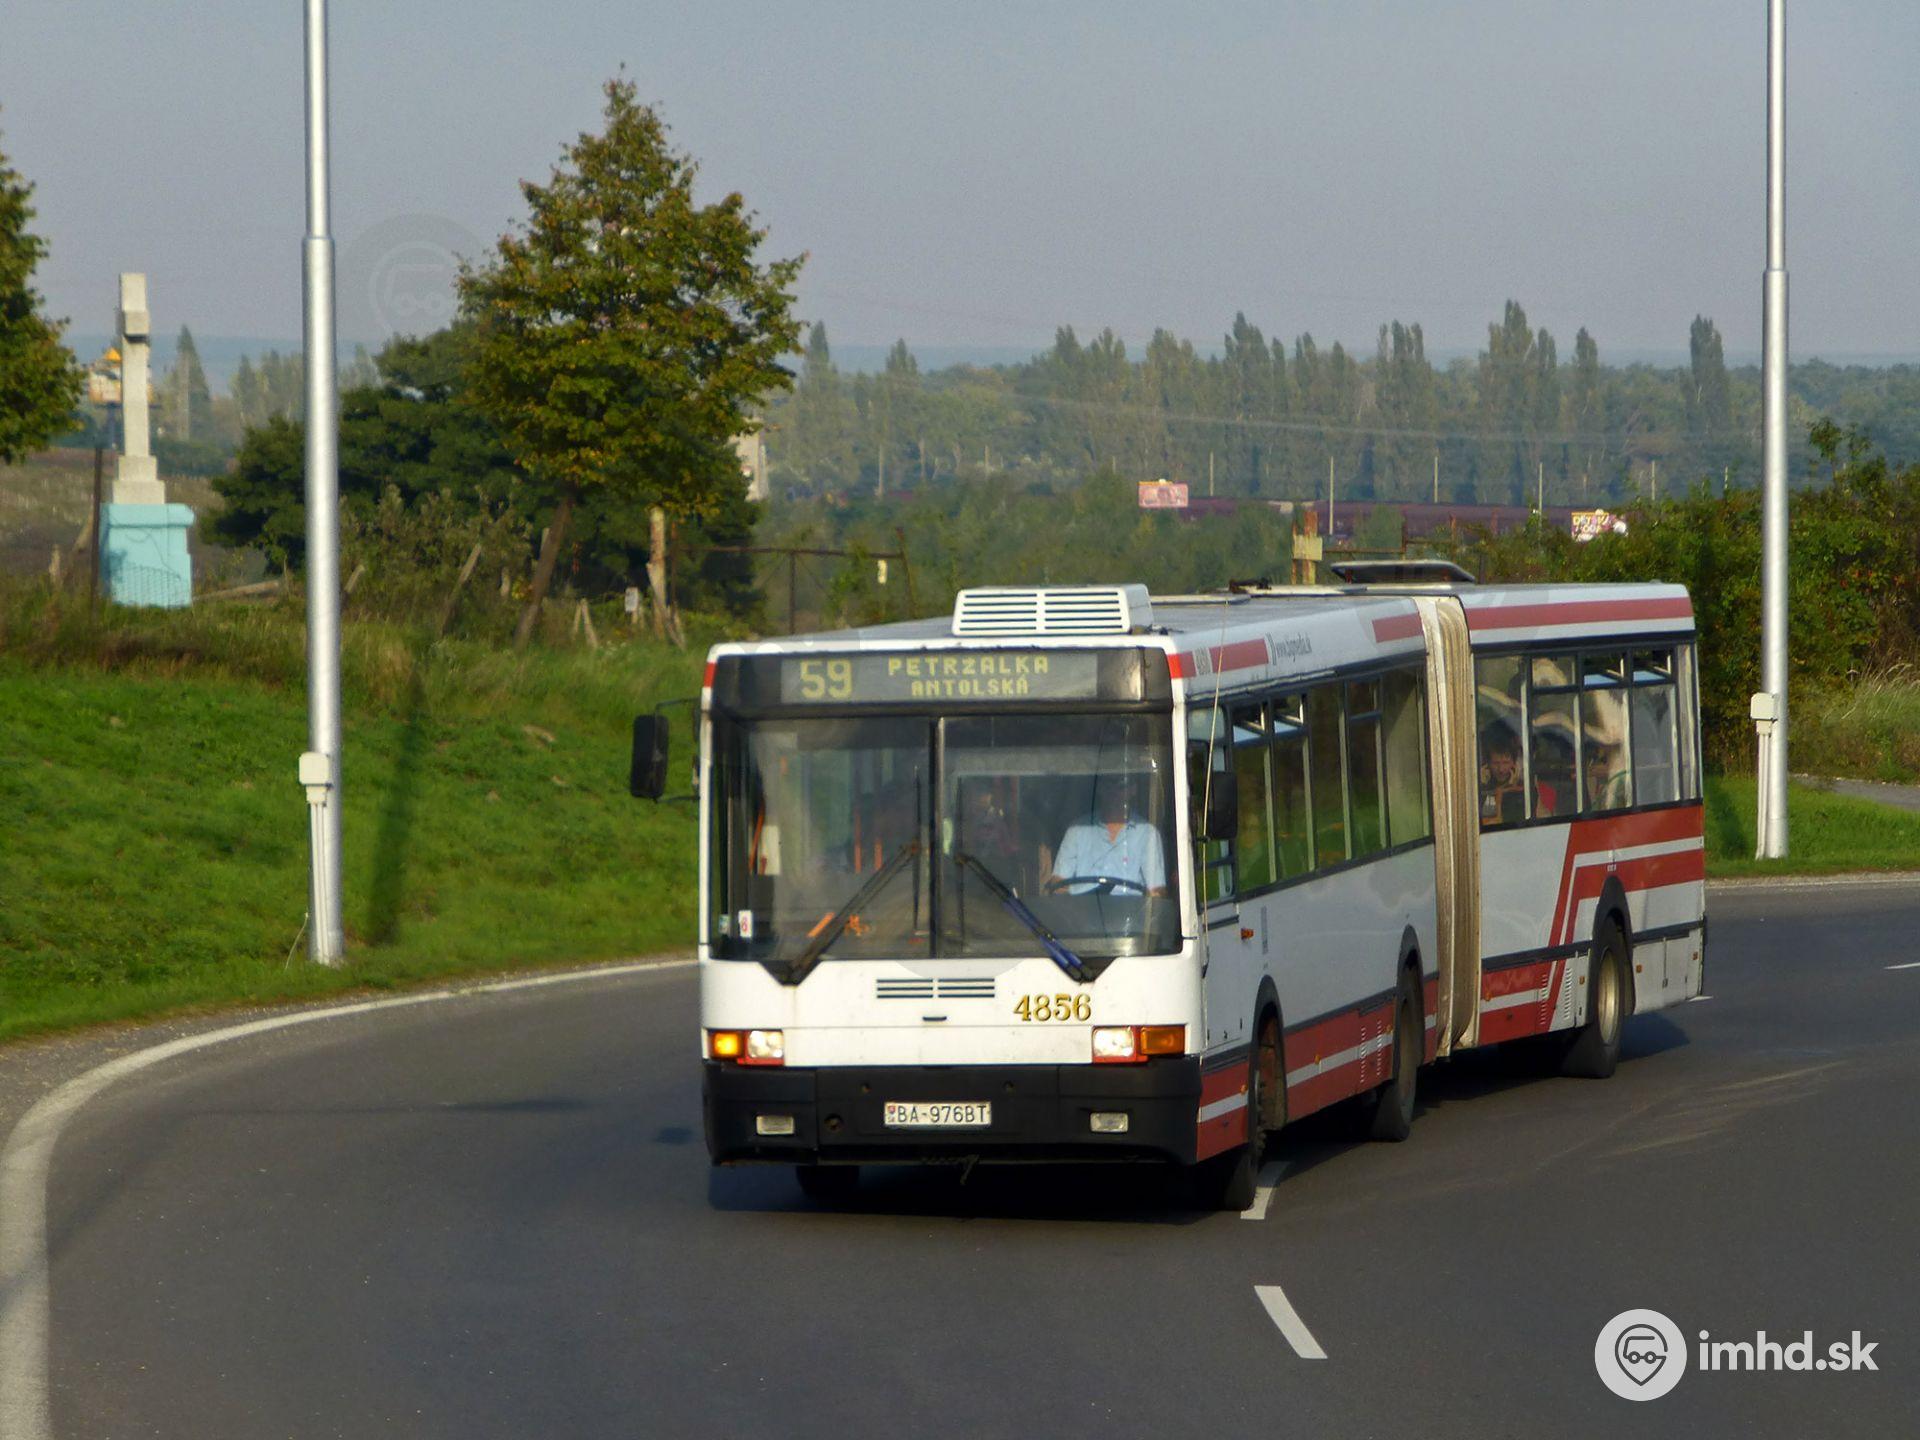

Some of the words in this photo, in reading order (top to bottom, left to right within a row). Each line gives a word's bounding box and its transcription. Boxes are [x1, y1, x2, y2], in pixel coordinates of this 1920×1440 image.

[800, 659, 853, 699] 59
[911, 675, 1028, 697] ANTOLSKÁ
[1013, 993, 1093, 1022] 4856
[897, 1105, 987, 1123] BA-976BT
